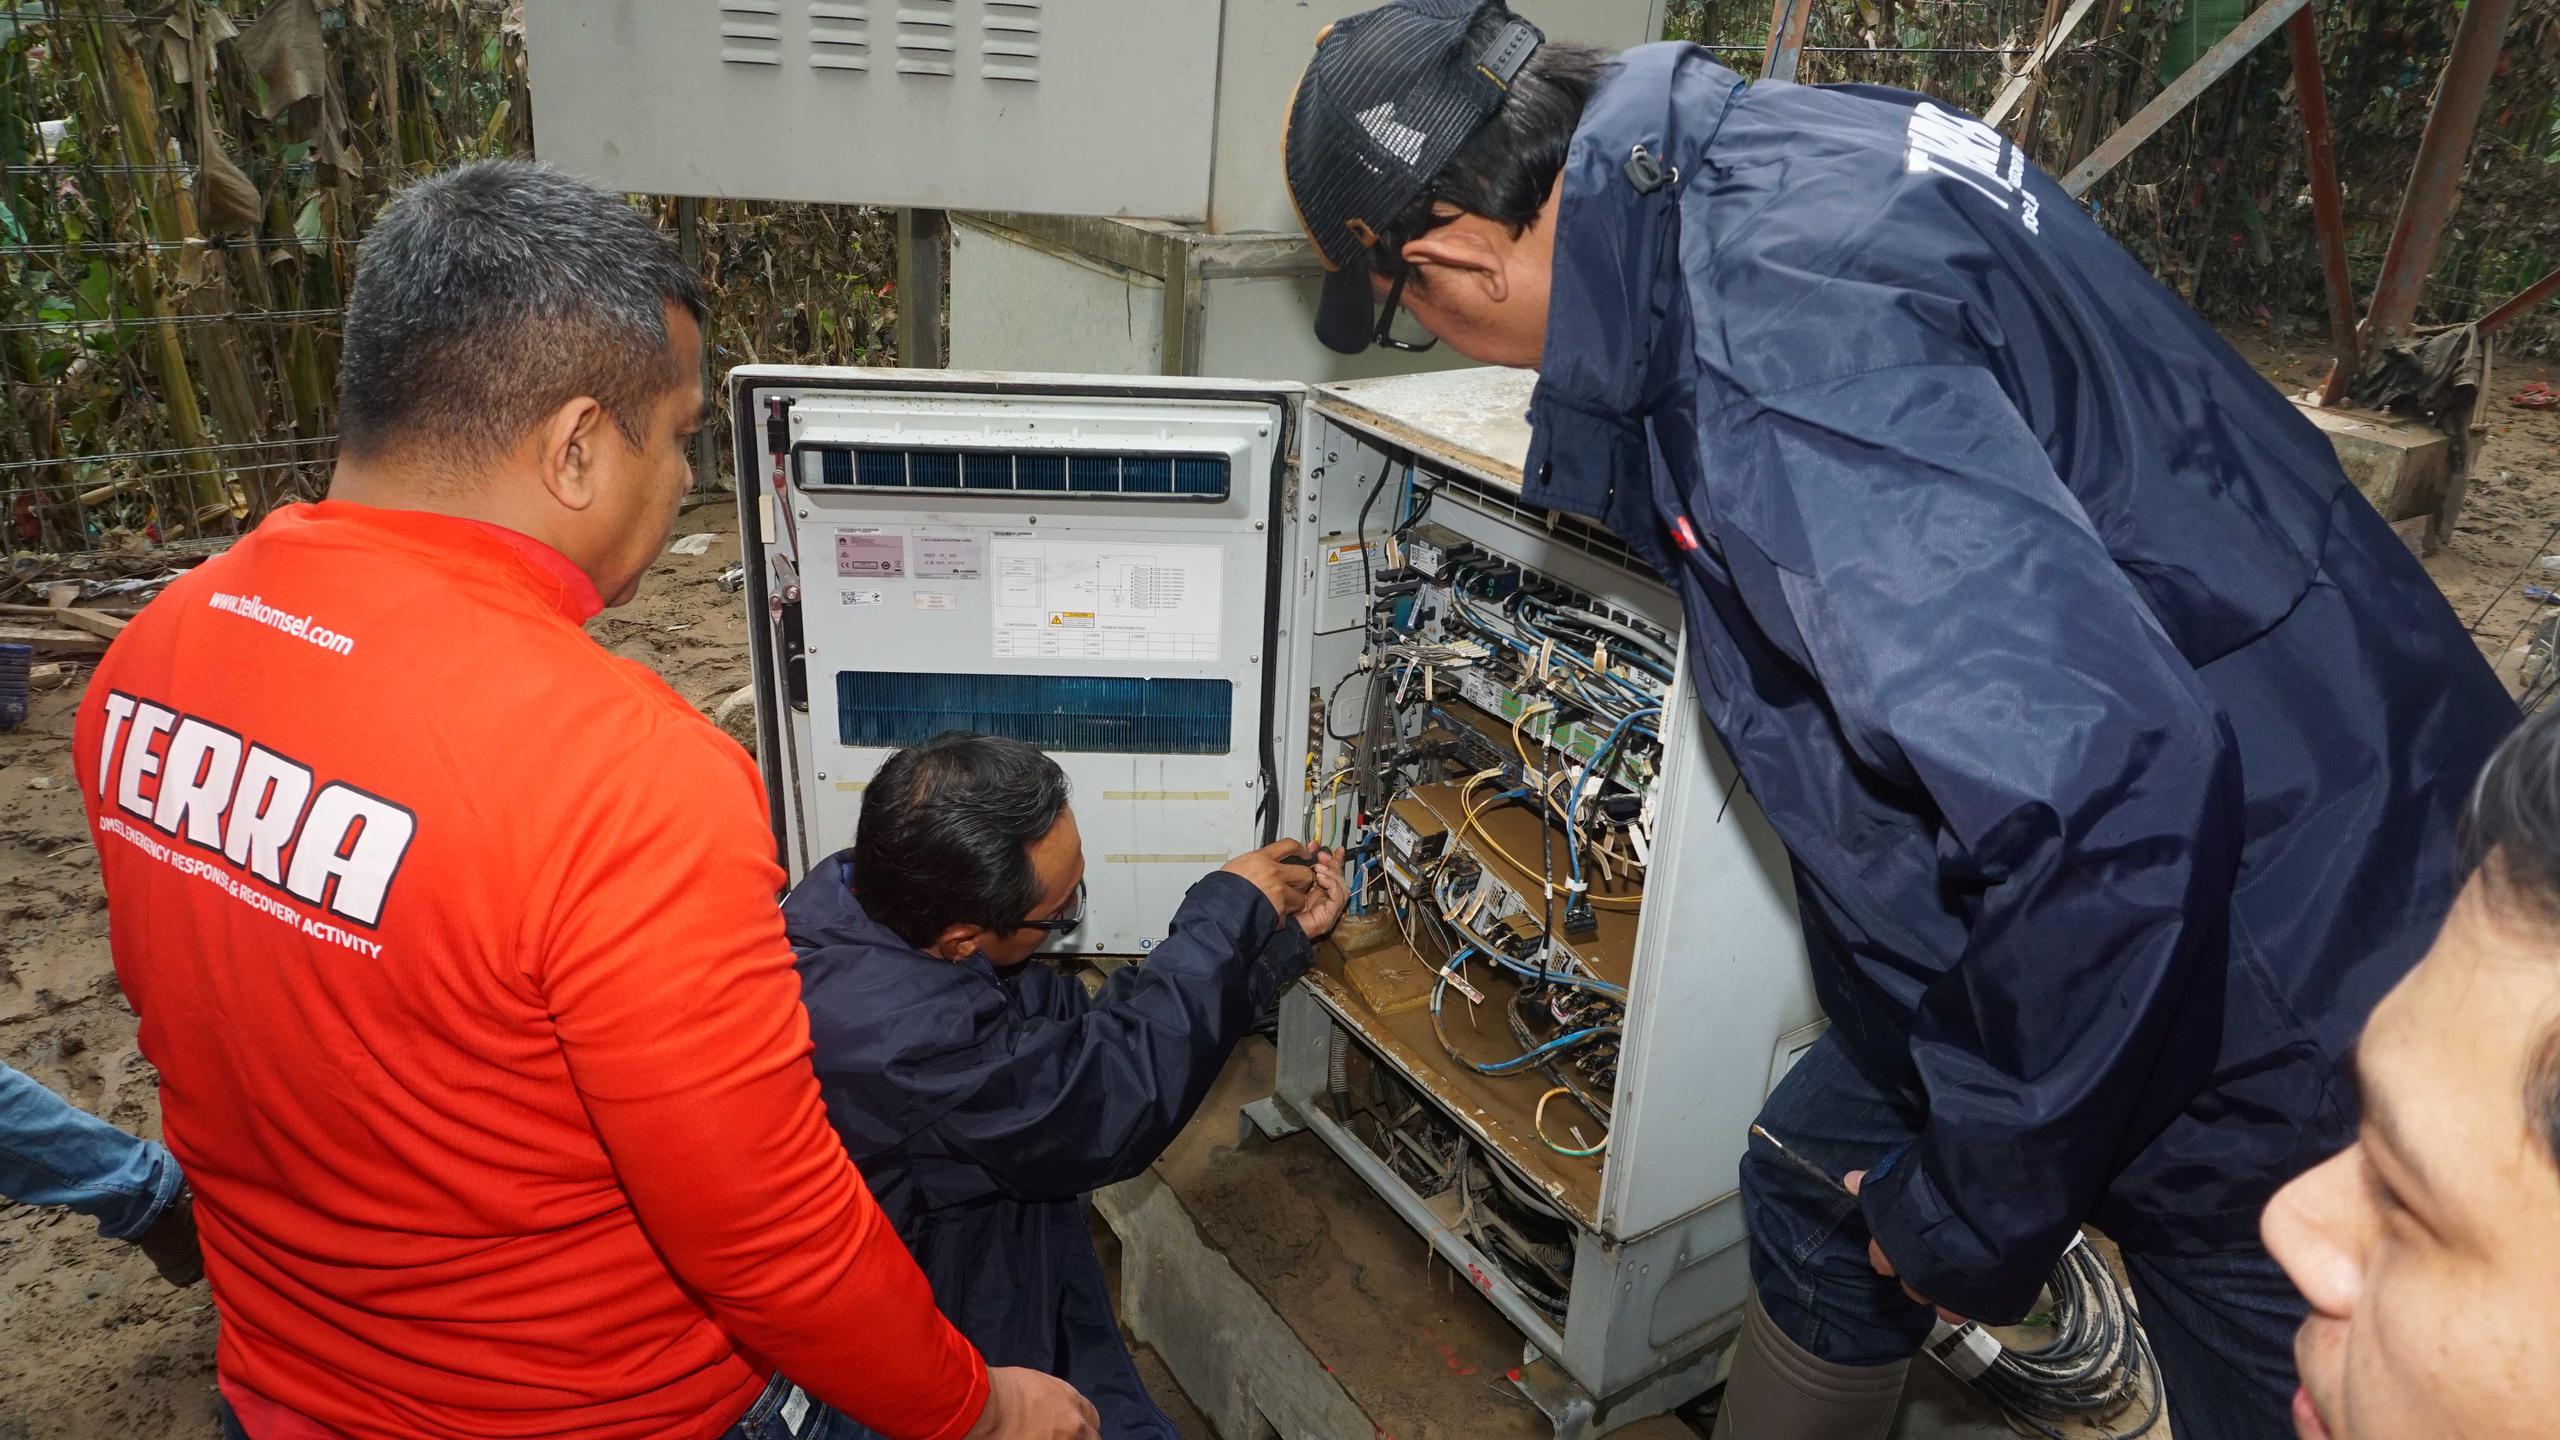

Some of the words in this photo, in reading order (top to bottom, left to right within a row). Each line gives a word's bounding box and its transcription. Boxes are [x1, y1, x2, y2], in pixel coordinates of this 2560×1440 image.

[208, 591, 354, 656] www.telkomsel.com
[99, 688, 417, 930] TERRA
[125, 824, 172, 864] EMERGENCY
[229, 879, 239, 898] &
[239, 883, 302, 929] RECOVERY
[302, 917, 383, 960] ACTIVITY
